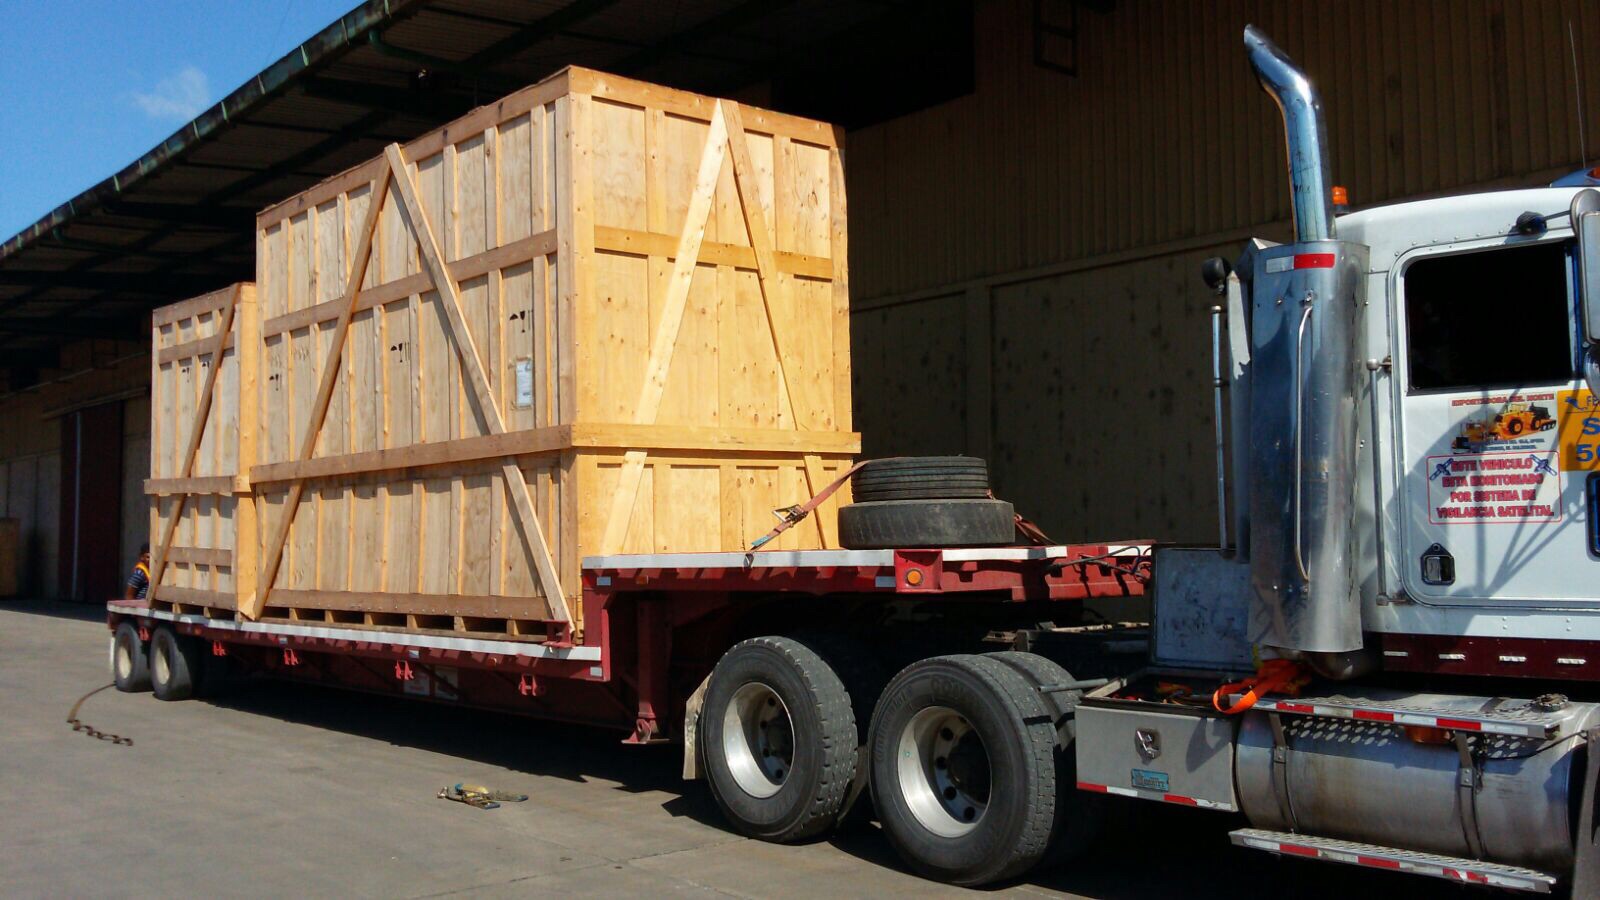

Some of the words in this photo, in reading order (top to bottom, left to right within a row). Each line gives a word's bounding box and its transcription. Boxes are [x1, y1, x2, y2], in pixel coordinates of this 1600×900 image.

[1576, 444, 1600, 462] 5
[1451, 460, 1477, 472] ESTE
[1479, 458, 1532, 471] VEHICULO
[1442, 475, 1468, 487] ESTA
[1450, 491, 1472, 502] POR
[1474, 489, 1520, 502] SISTEMA
[1522, 489, 1536, 500] DE
[1437, 506, 1495, 518] VIGILANCIA
